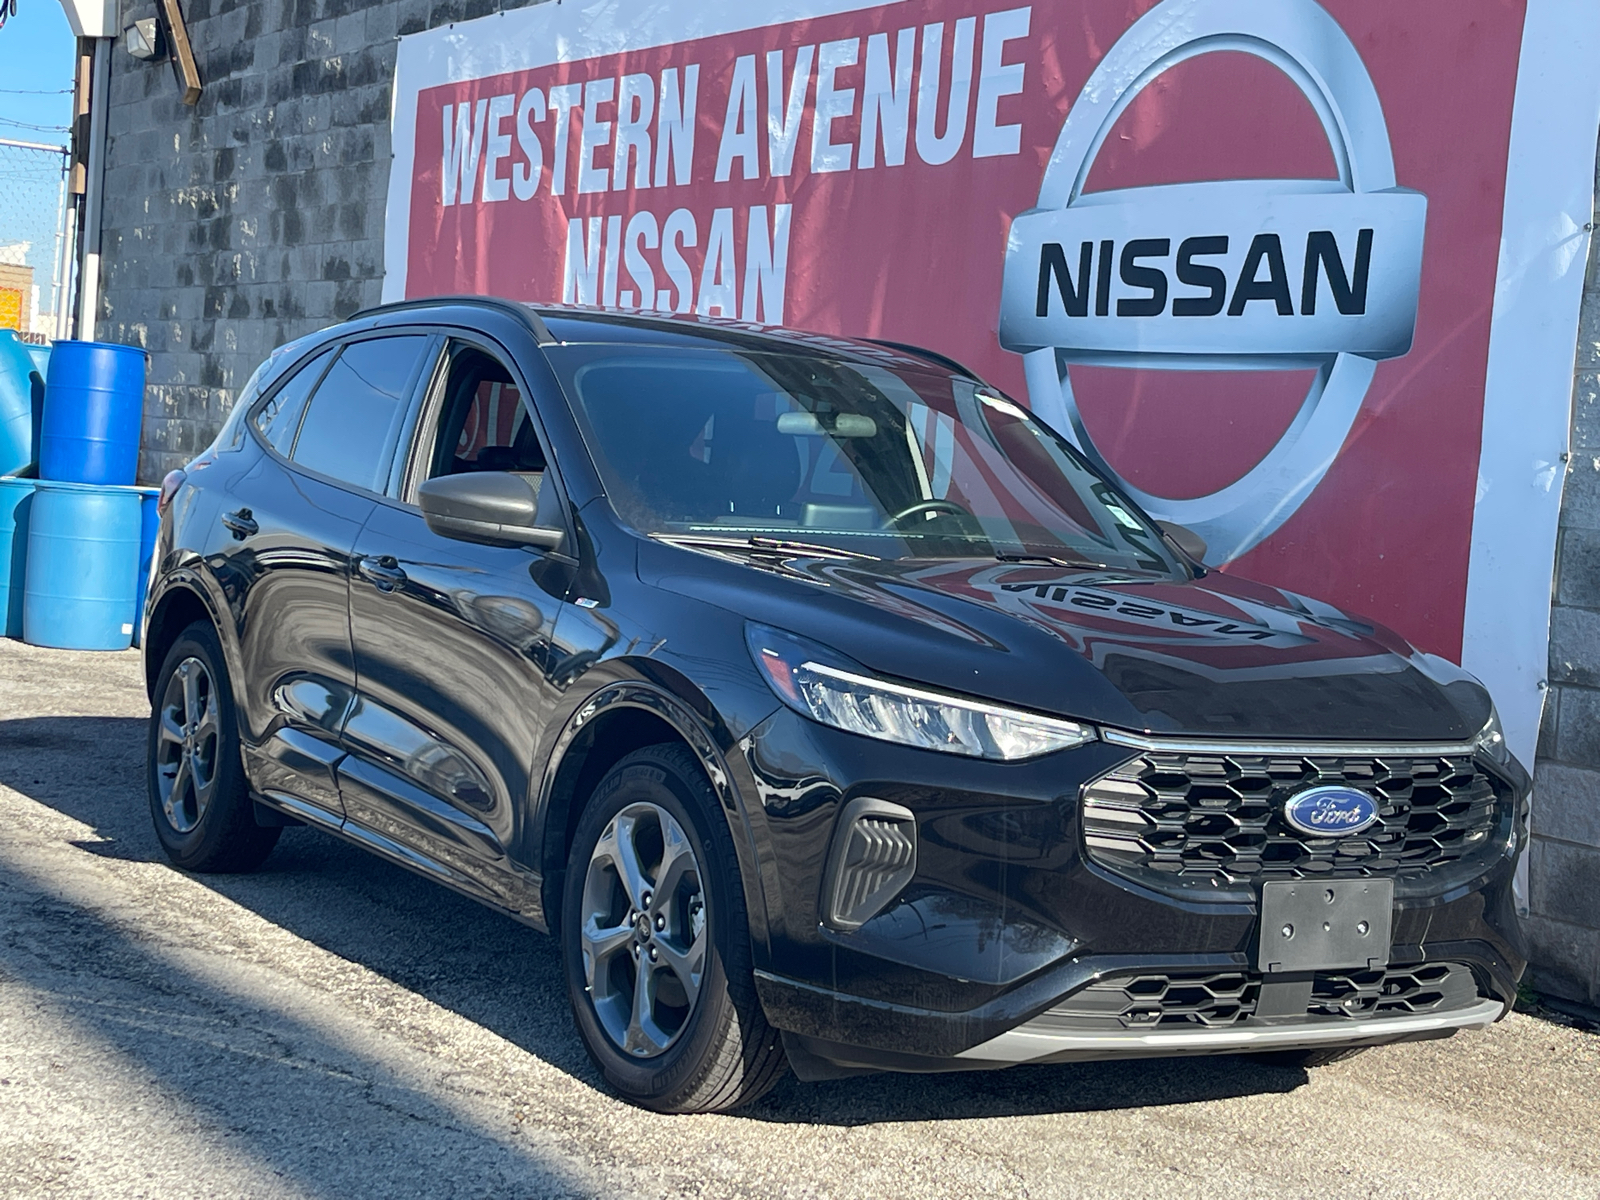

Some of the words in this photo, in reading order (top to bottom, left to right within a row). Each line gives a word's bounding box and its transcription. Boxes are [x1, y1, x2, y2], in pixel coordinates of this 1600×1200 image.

[442, 64, 700, 207] WESTERN
[714, 6, 1032, 182] AVENUE
[562, 203, 793, 326] NISSAN
[1035, 228, 1374, 317] NISSAN
[1310, 796, 1361, 824] Ford
